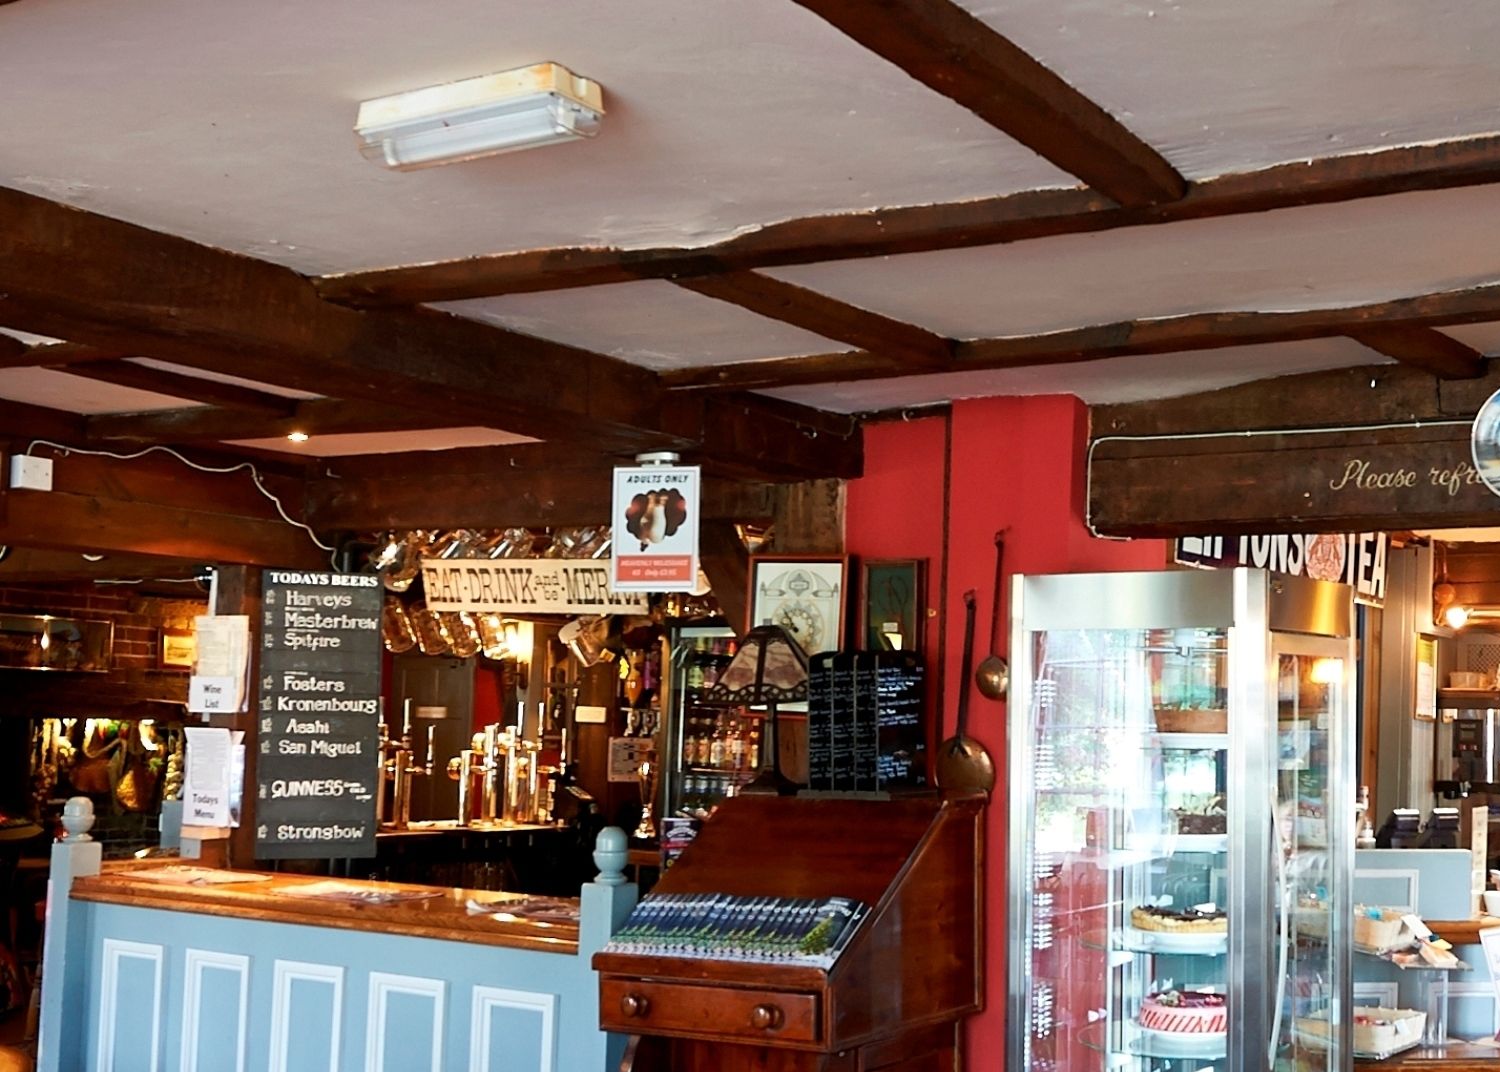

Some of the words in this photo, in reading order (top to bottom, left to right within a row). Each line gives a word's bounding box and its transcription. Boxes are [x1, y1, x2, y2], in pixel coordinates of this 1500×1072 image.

[626, 475, 661, 484] ADULTS
[664, 475, 689, 484] ONLY
[1329, 459, 1417, 490] Please
[270, 571, 330, 586] TODAYS
[331, 574, 379, 588] BEERS
[425, 568, 464, 602] EAT
[466, 568, 537, 605] DRINK
[535, 573, 561, 587] and
[562, 567, 643, 606] MER
[285, 589, 353, 610] Harveys
[544, 586, 559, 601] be
[283, 611, 379, 630] Masterbrew
[283, 632, 342, 652] Spitfire
[203, 684, 222, 695] Wine
[283, 675, 346, 693] Fosters
[205, 699, 219, 709] List
[277, 695, 378, 714] Kronenbourg
[285, 718, 331, 734] Asahi
[278, 739, 307, 755] San
[310, 739, 362, 758] Miguel
[271, 779, 345, 799] GUINNESS
[192, 793, 219, 806] Todays
[194, 808, 215, 820] Menu
[276, 824, 366, 841] Strongbow
